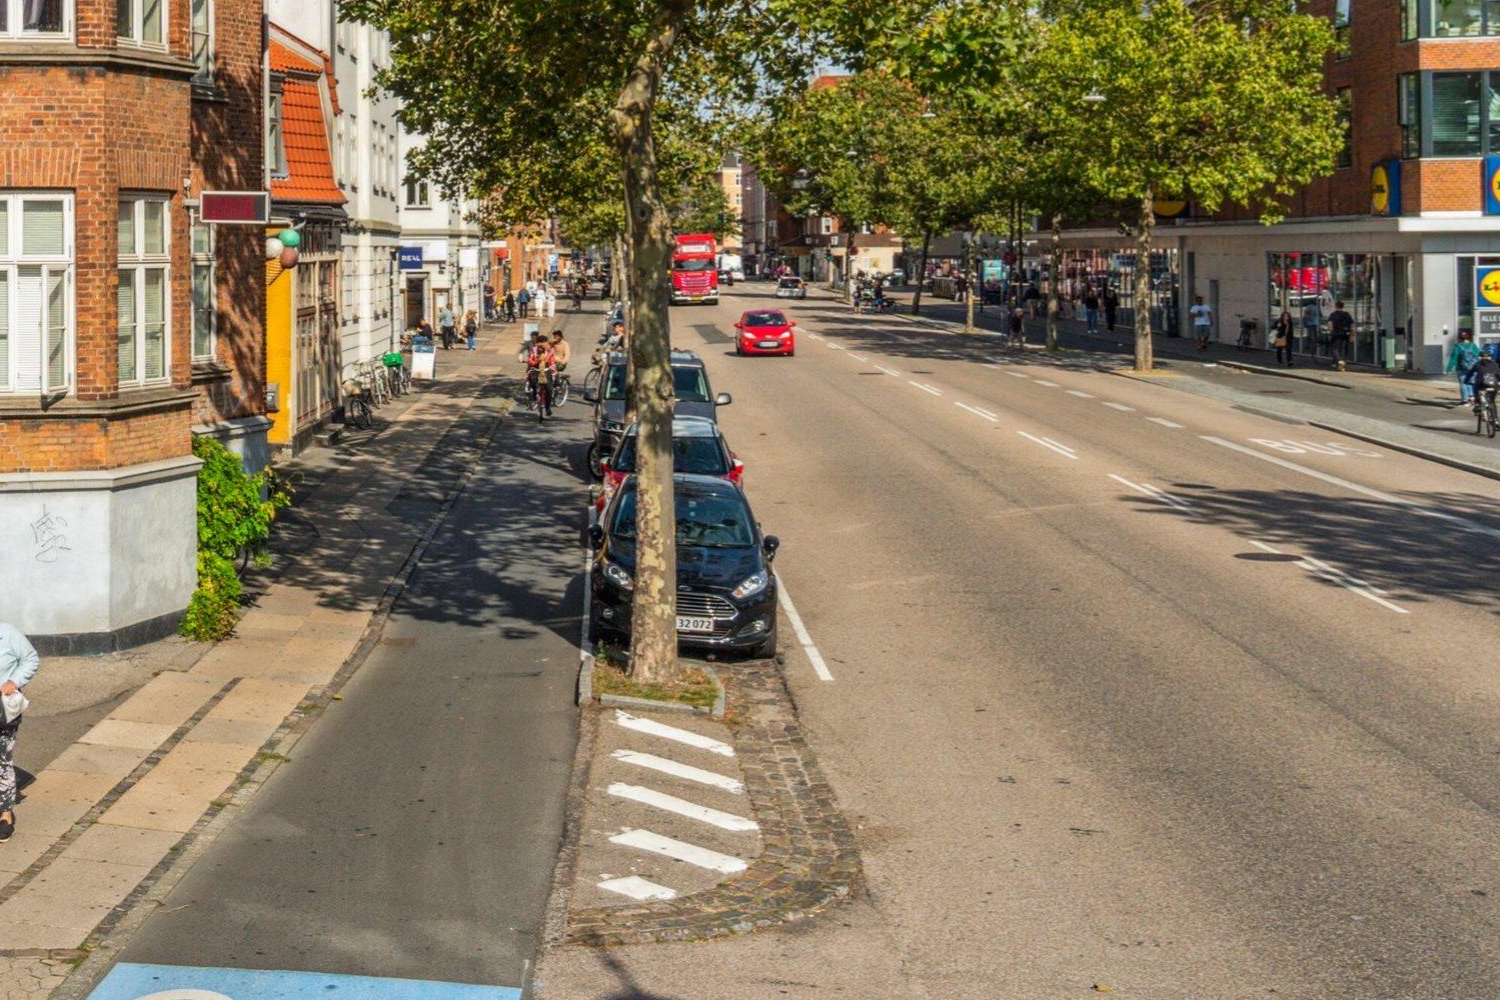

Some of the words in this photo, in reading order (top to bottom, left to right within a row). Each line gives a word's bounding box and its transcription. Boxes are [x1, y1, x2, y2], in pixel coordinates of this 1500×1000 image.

[1248, 438, 1384, 457] BUS
[678, 618, 690, 628] 32
[692, 619, 712, 629] 072
